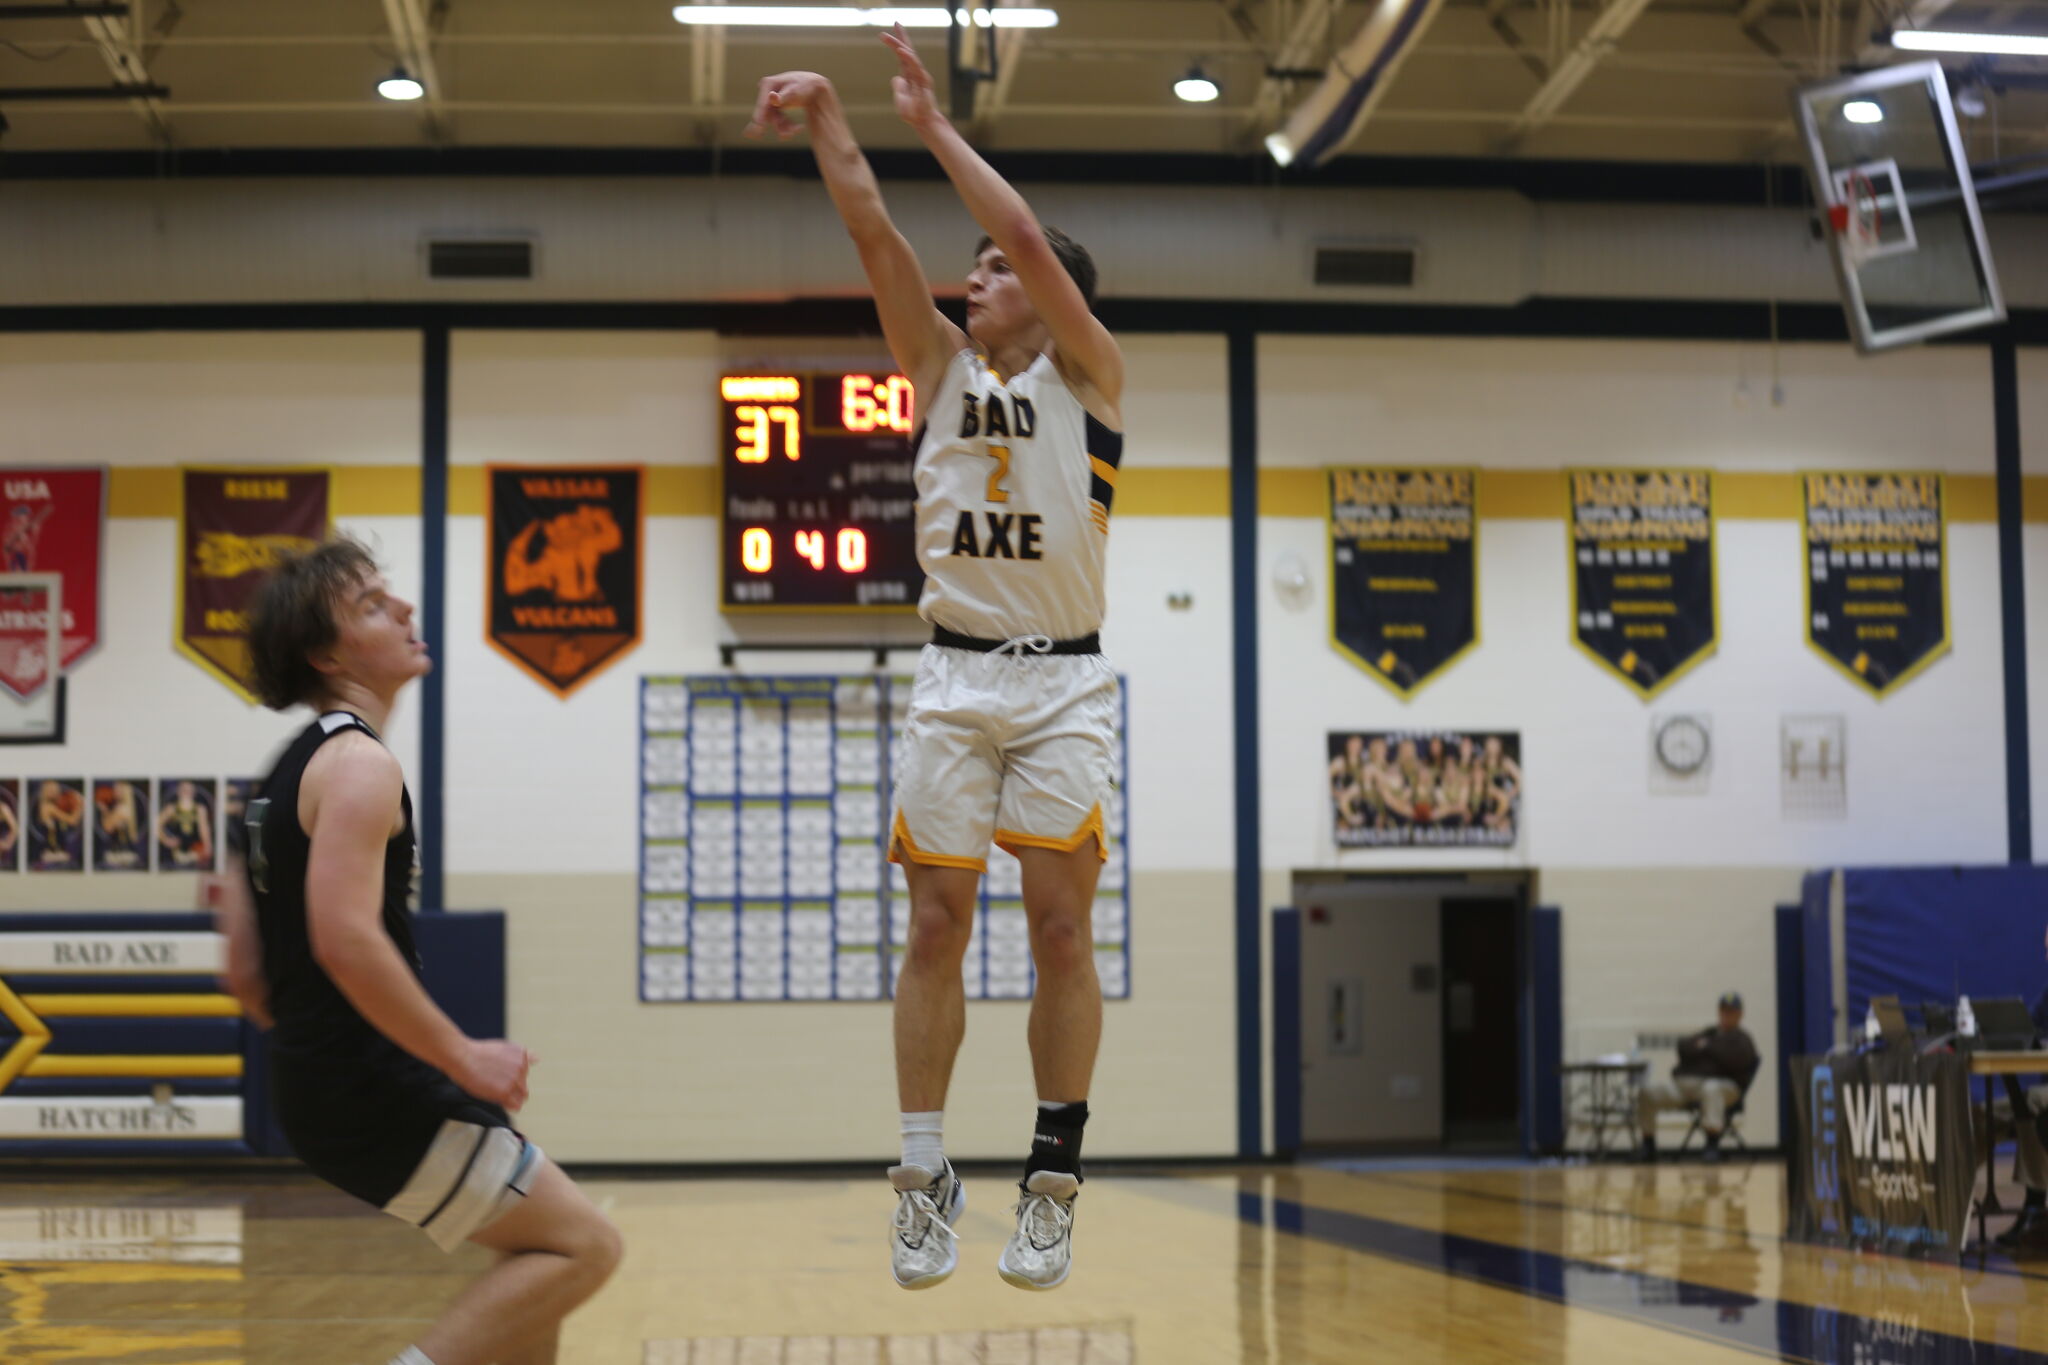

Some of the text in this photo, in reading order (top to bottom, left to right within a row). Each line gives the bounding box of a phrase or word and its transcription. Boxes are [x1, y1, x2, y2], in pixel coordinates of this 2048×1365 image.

[736, 406, 799, 463] 37
[958, 391, 1036, 439] BAD
[4, 480, 50, 500] USA
[224, 479, 288, 499] REESE
[520, 478, 609, 498] VASSAR
[985, 444, 1012, 503] 2
[951, 510, 1043, 561] AXE
[511, 606, 618, 627] VULCANS
[53, 942, 177, 965] BAD AXE
[1842, 1081, 1937, 1164] WLEW
[1872, 1164, 1920, 1208] Sports
